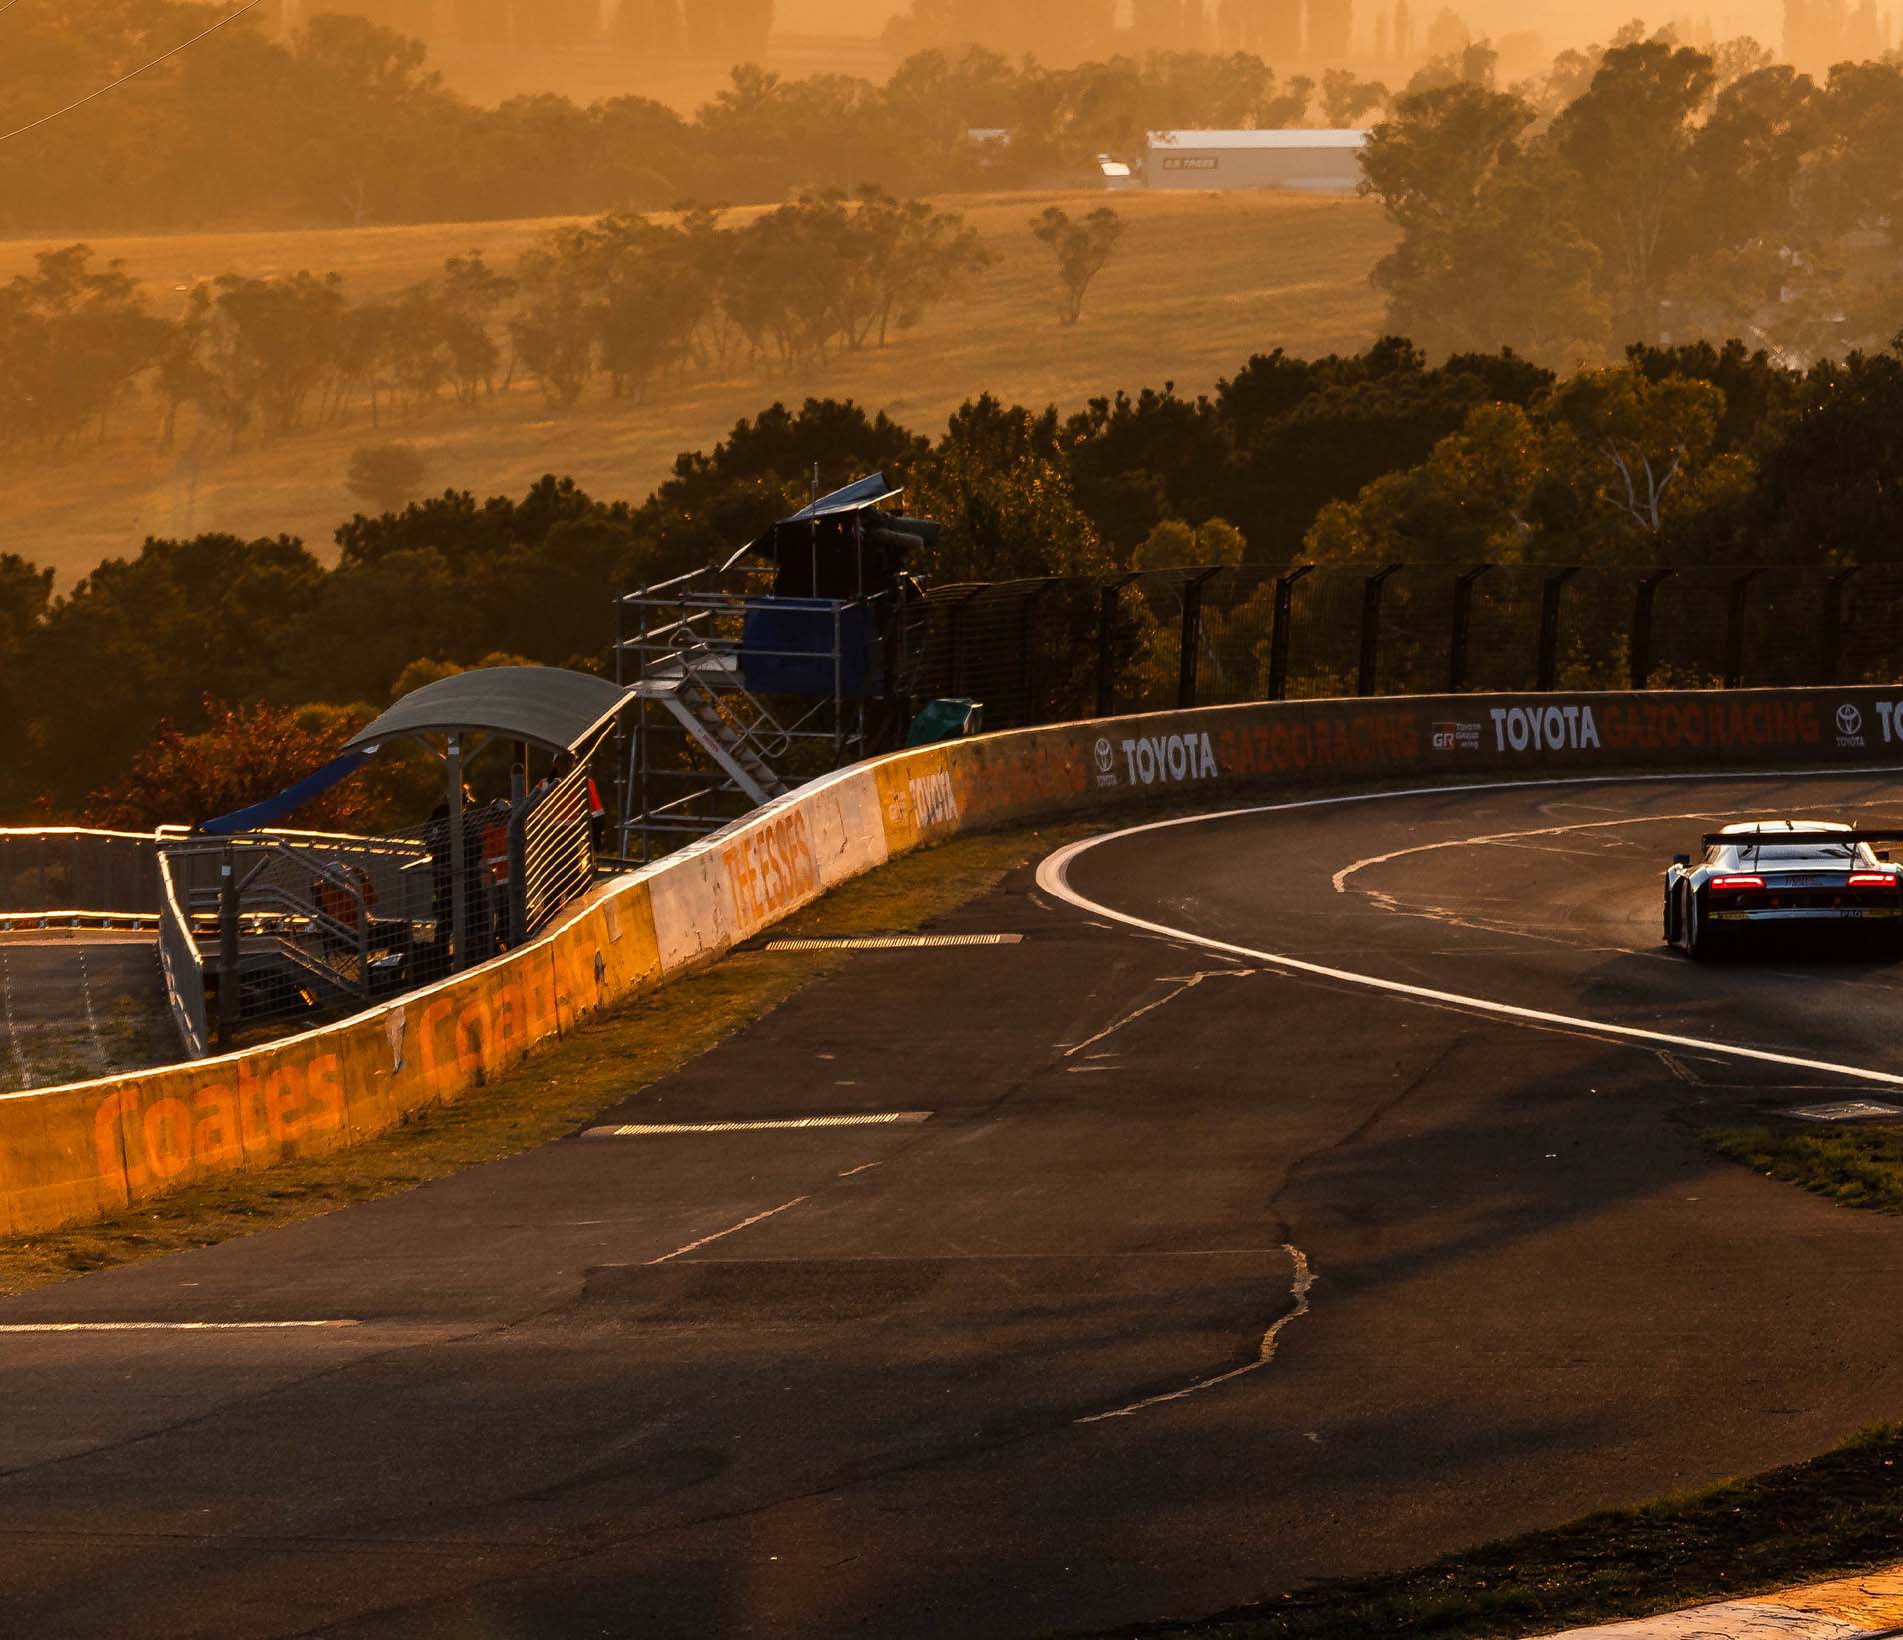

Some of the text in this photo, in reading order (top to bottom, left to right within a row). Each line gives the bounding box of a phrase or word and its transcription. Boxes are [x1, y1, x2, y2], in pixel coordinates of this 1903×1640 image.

[1433, 732, 1454, 747] GR
[1490, 705, 1601, 752] TOYOTA
[1121, 732, 1218, 785] TOYOTA
[909, 771, 960, 827] TOYOTA
[95, 1054, 344, 1187] Coates
